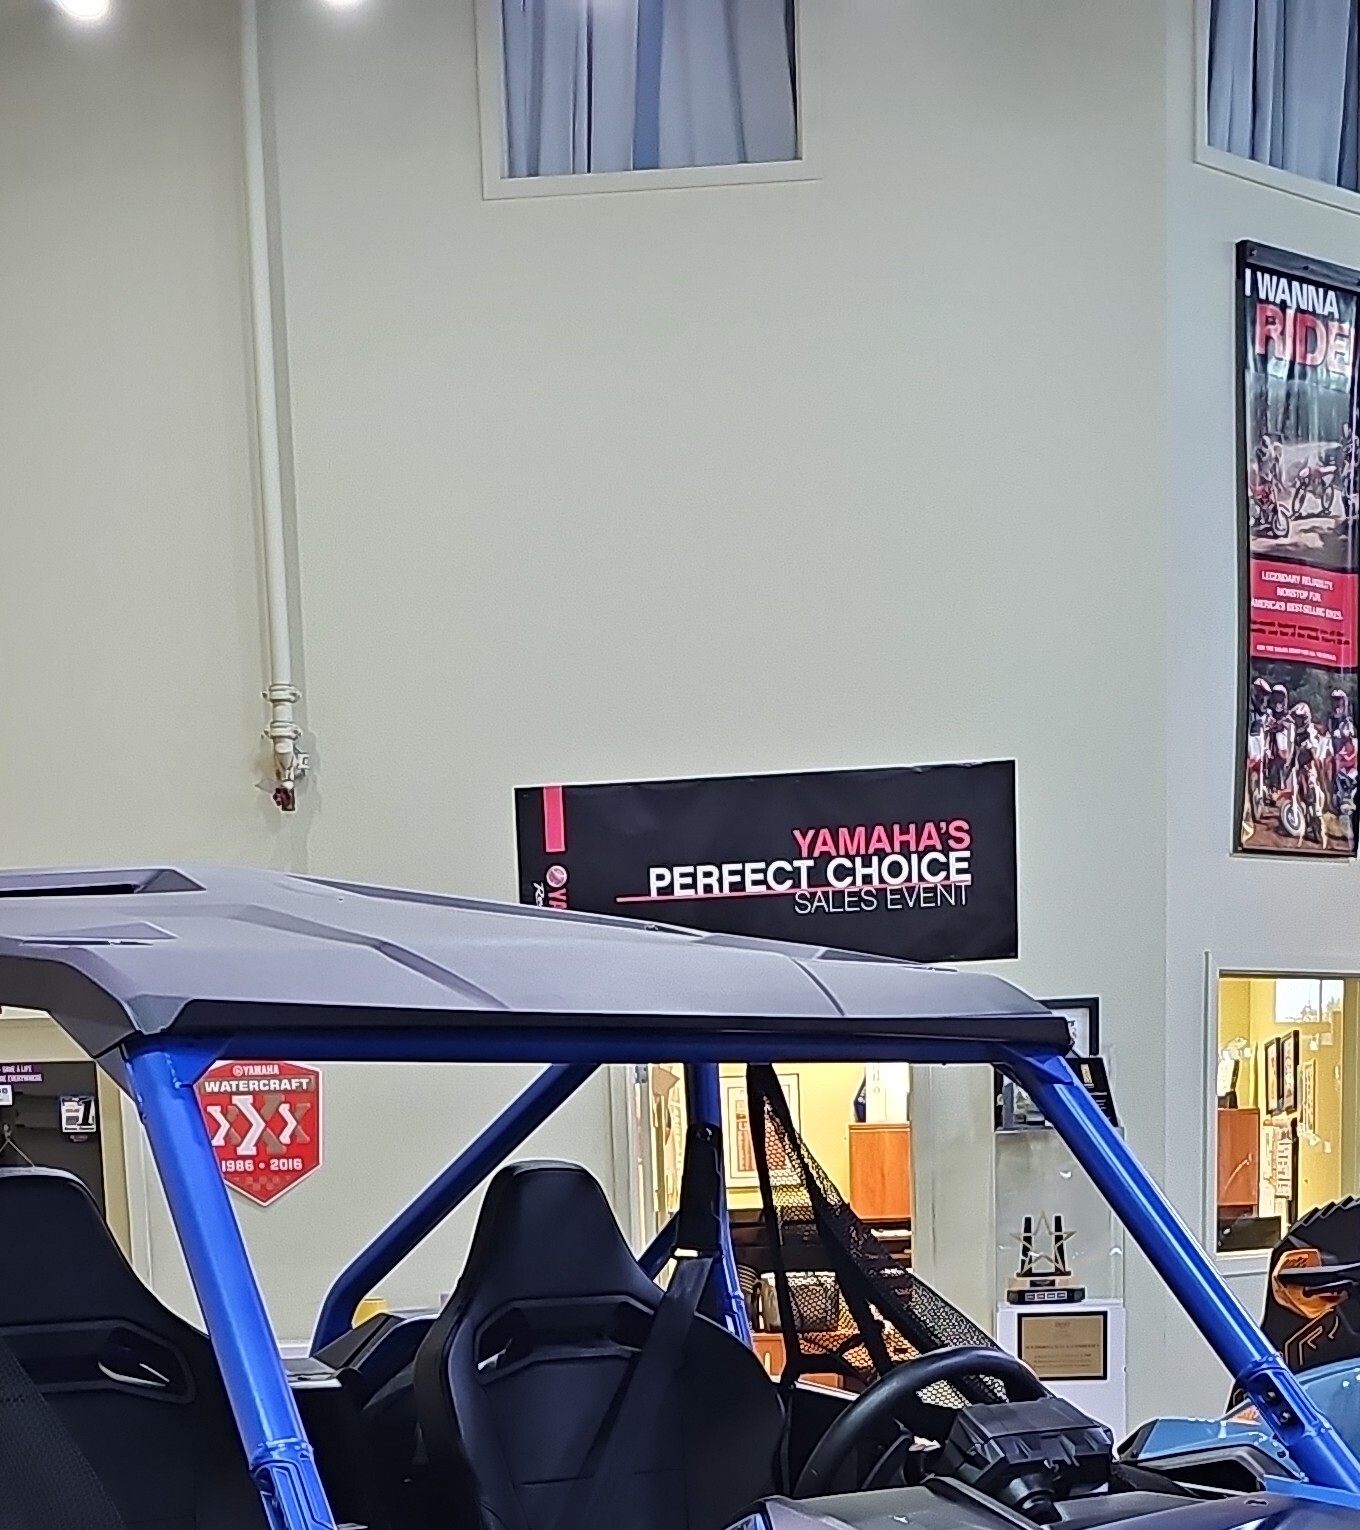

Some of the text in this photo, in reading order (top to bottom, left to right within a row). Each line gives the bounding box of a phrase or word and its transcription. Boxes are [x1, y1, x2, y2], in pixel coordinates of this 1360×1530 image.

[1245, 268, 1339, 319] I WANNA
[793, 820, 972, 858] YAMAHA'S
[649, 851, 972, 897] PERFECT CHOICE
[794, 883, 970, 915] SALES EVENT
[204, 1078, 310, 1093] WATERCRAFT
[243, 1064, 280, 1076] YAMAHA
[221, 1158, 303, 1173] 1986 2016
